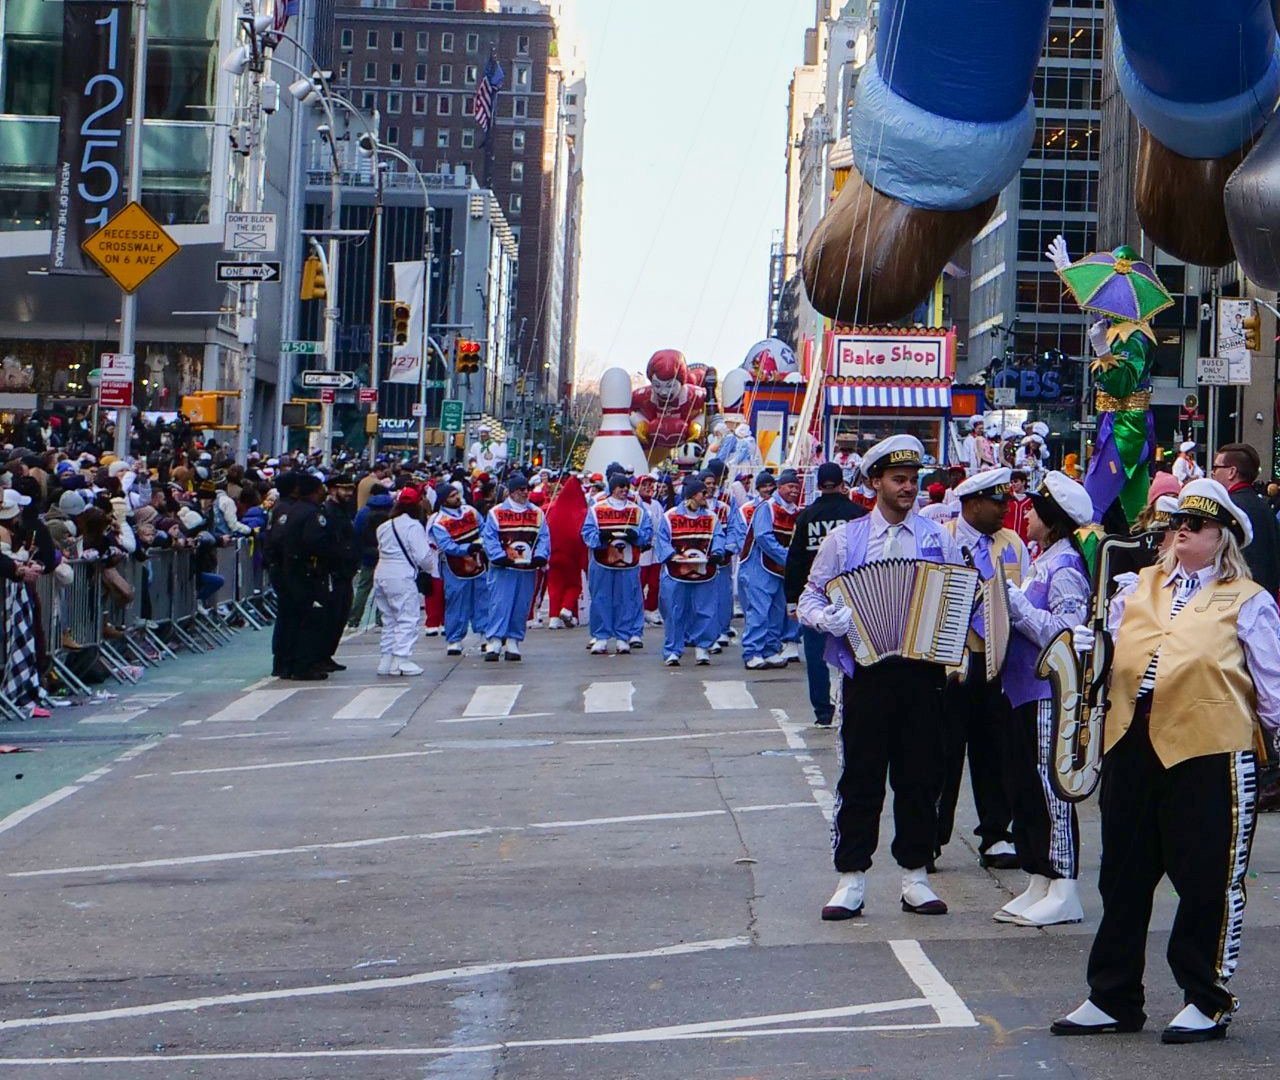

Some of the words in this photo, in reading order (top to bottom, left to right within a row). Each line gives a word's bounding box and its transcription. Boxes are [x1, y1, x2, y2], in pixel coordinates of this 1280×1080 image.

[60, 161, 71, 195] AVENUE
[60, 195, 68, 208] OF
[58, 208, 67, 226] THE
[104, 229, 160, 240] RECESSED
[54, 225, 66, 268] AMERICAS
[99, 241, 164, 253] CROSSWALK
[105, 254, 121, 264] ON
[124, 254, 130, 264] 6
[136, 255, 157, 265] AVE
[226, 267, 244, 276] ONE
[253, 267, 270, 277] WAY
[292, 342, 307, 352] 50
[1219, 339, 1246, 350] MORMO
[843, 347, 885, 365] Bake
[891, 345, 936, 365] Shop
[994, 368, 1060, 398] CBS
[378, 418, 415, 429] ercury
[808, 520, 847, 537] NY
